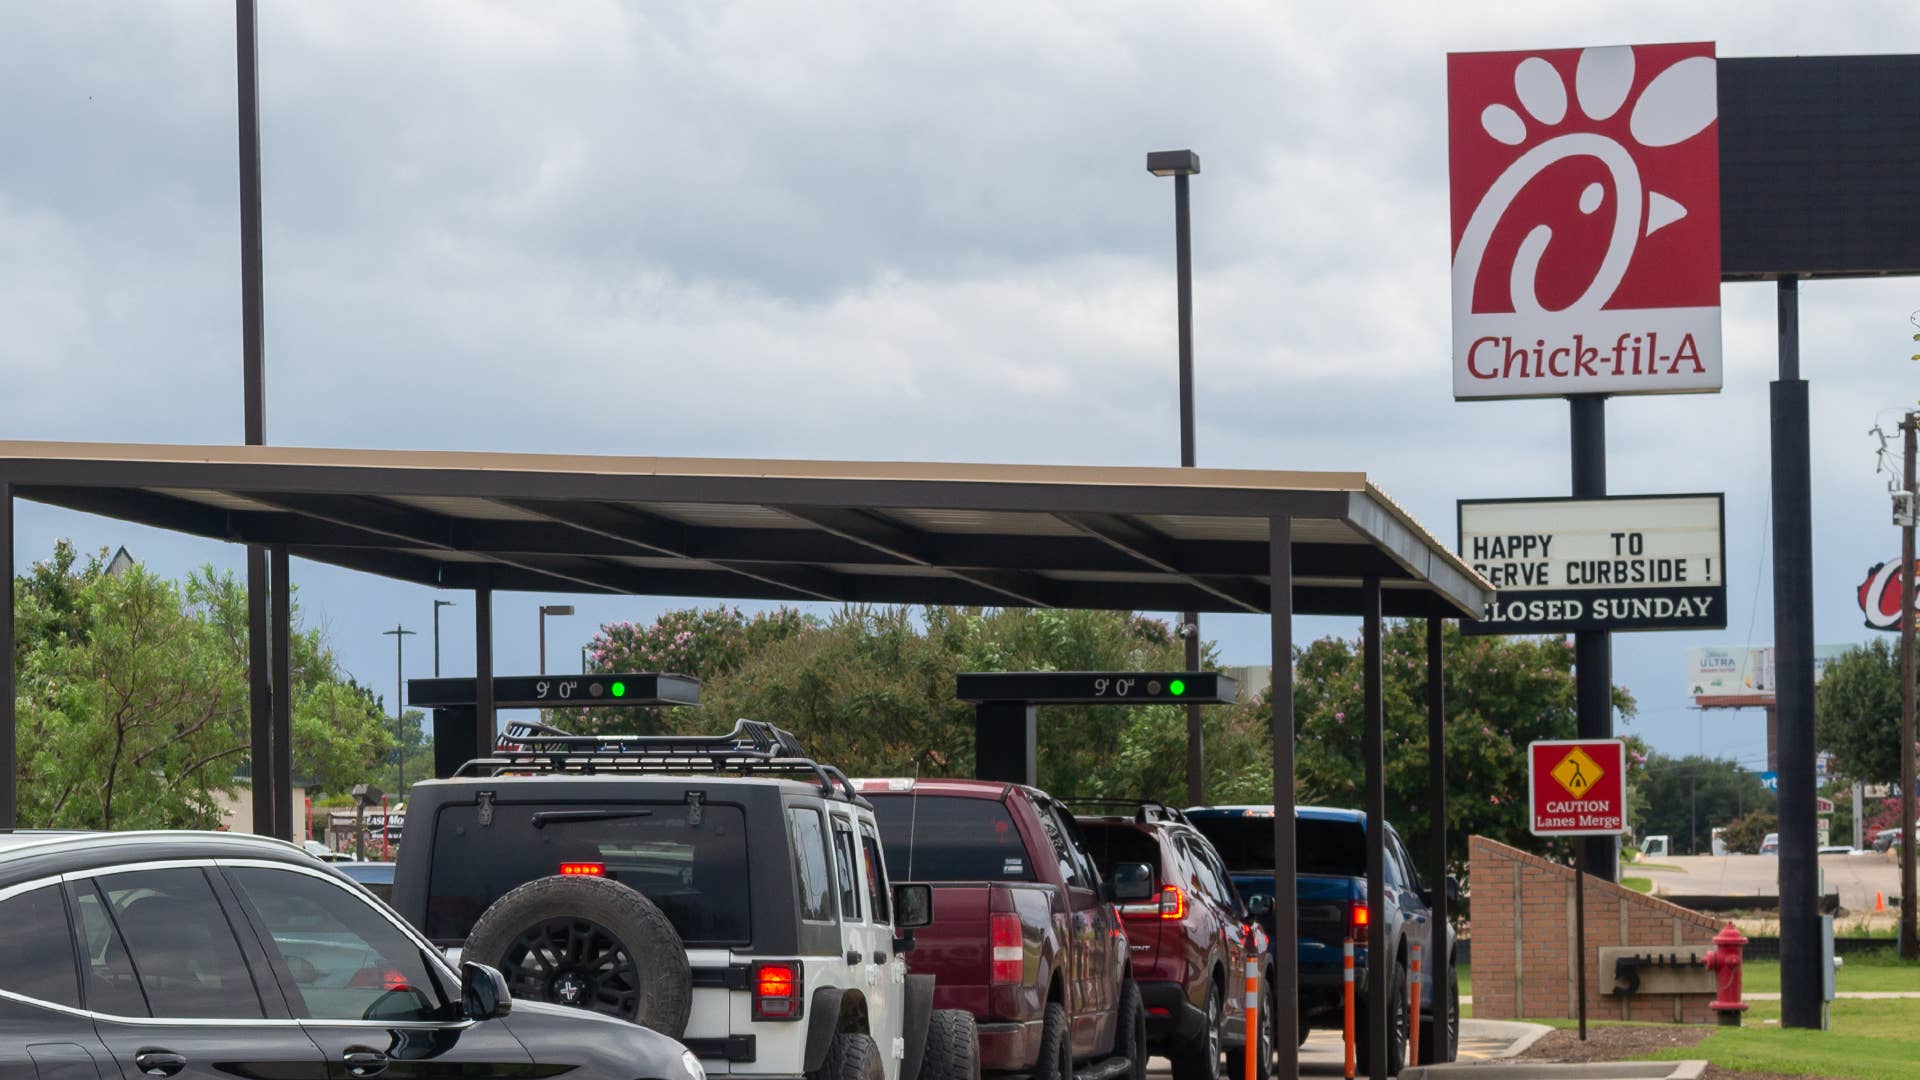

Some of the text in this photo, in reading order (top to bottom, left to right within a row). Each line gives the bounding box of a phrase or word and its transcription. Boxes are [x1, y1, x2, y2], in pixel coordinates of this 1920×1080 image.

[1467, 332, 1705, 380] Chick-fil-A
[1473, 532, 1643, 560] HAPPY TO
[1566, 558, 1687, 585] CURBSIDE
[1592, 597, 1713, 620] SUNDAY
[1699, 658, 1736, 668] ULTRA
[1546, 800, 1610, 813] CAUTION
[1537, 815, 1620, 829] Lanes Merge
